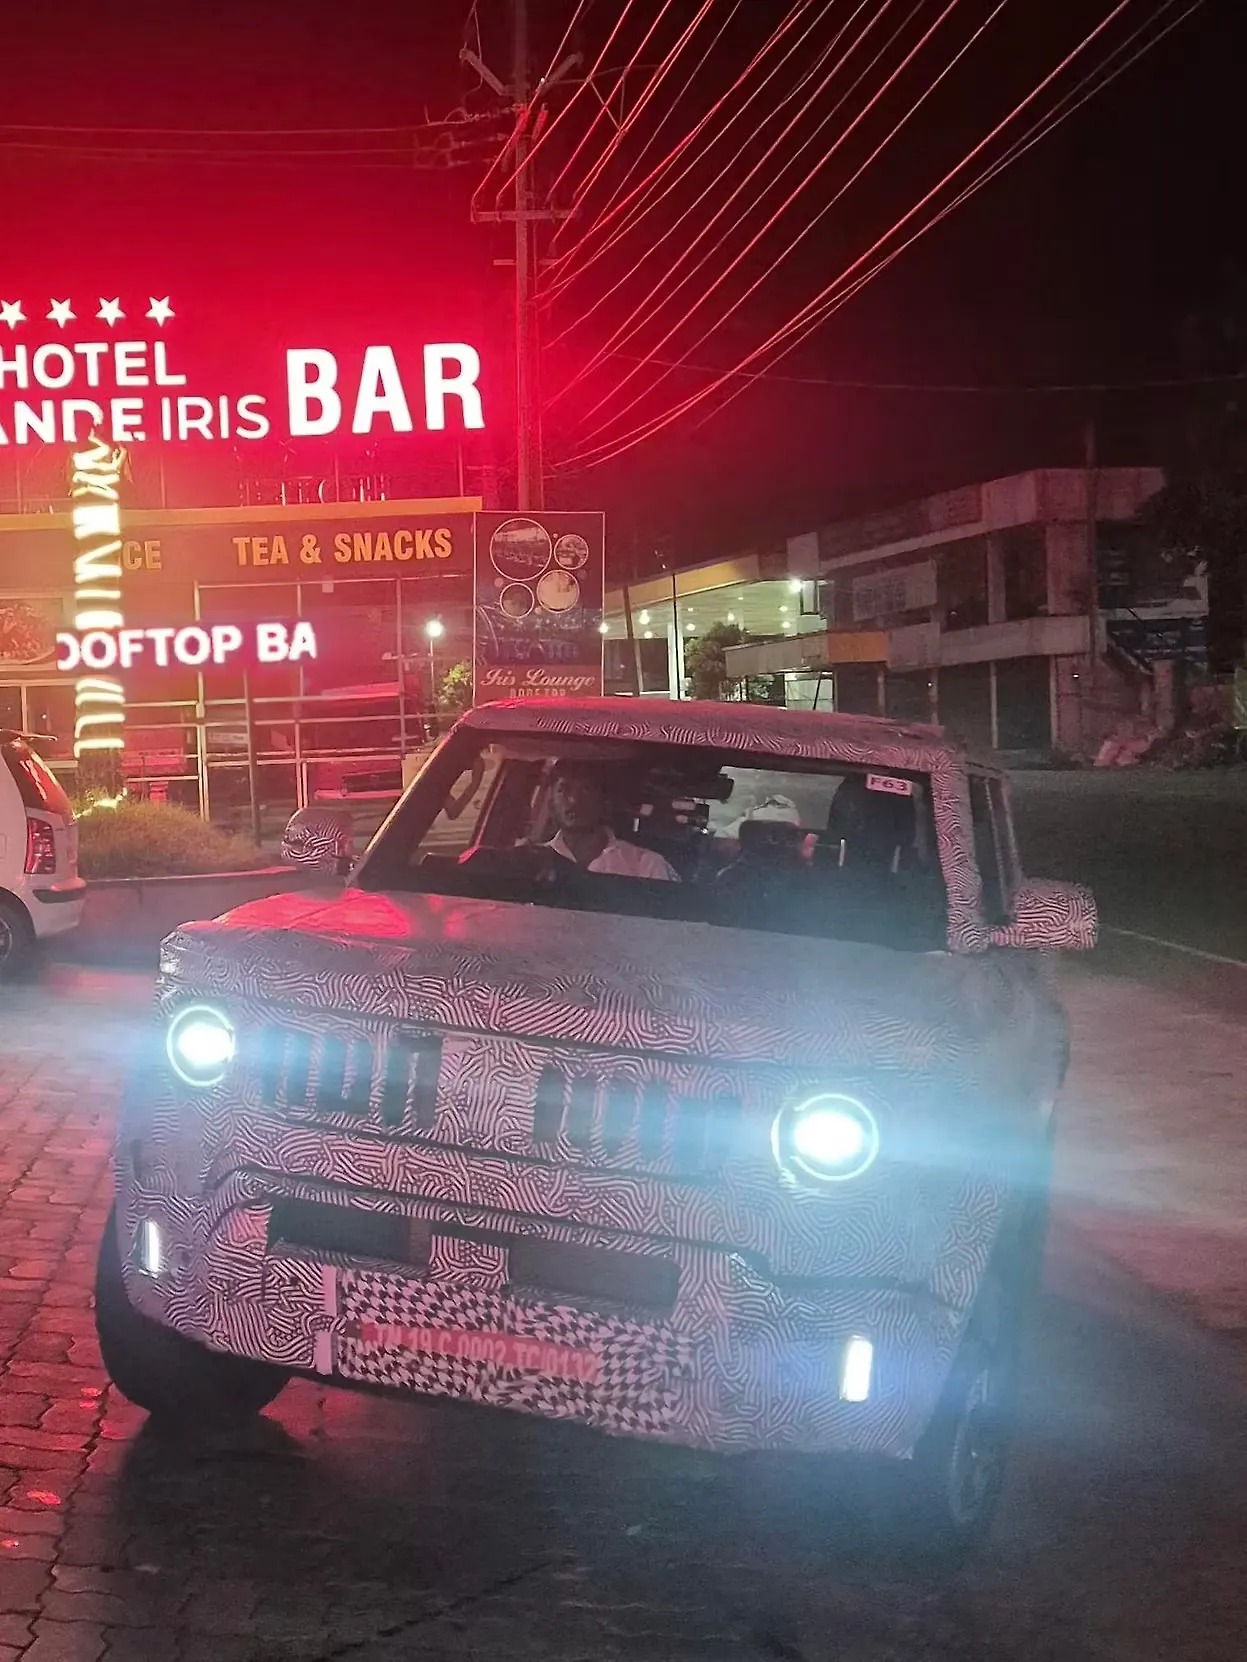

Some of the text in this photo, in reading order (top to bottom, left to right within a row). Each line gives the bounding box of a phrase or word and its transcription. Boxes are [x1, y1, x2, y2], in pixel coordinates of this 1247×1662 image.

[0, 341, 187, 389] HOTEL
[286, 342, 485, 436] BAR
[161, 394, 270, 441] IRIS
[232, 528, 452, 566] TEA & SNACKS
[480, 668, 596, 691] Iris Lounge
[870, 777, 908, 792] F63
